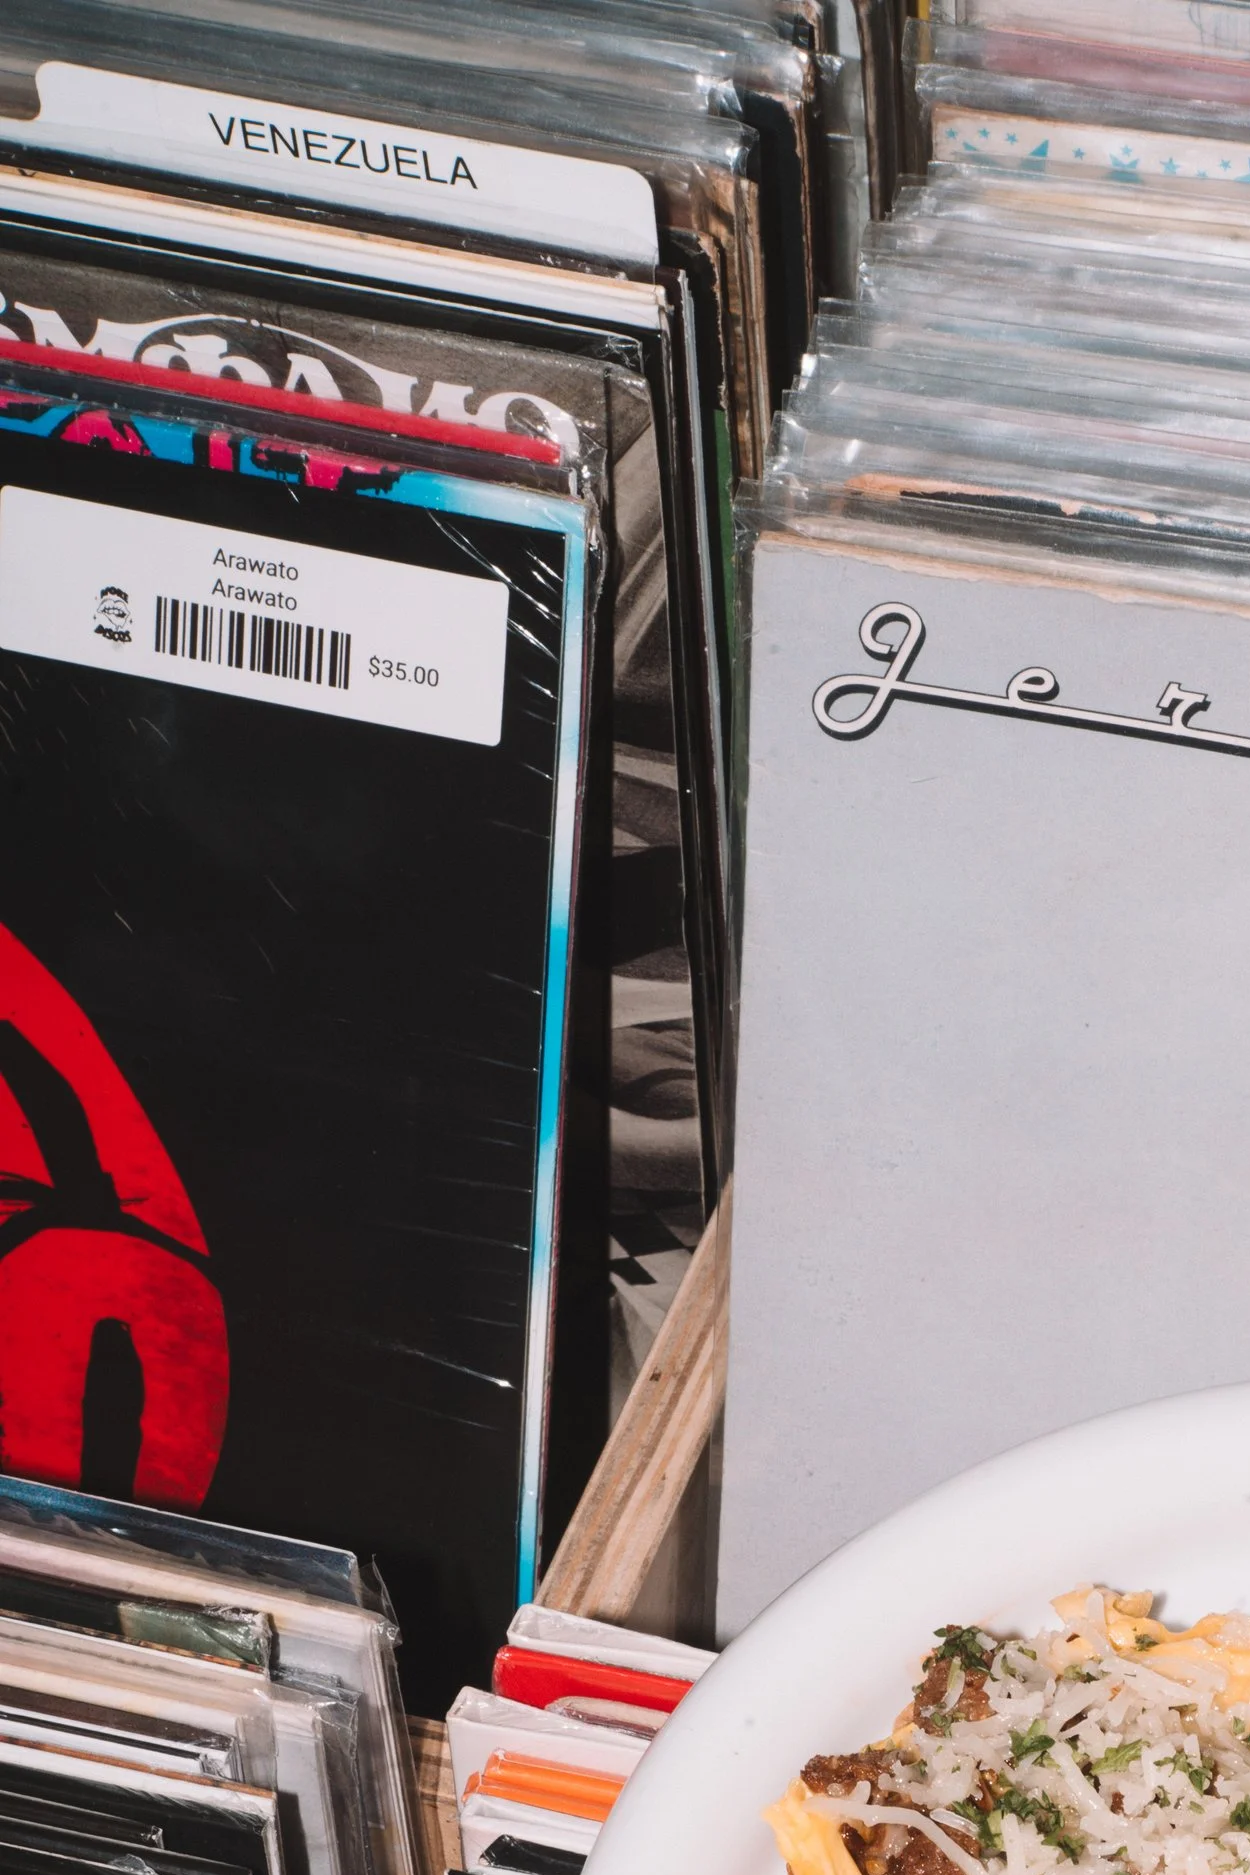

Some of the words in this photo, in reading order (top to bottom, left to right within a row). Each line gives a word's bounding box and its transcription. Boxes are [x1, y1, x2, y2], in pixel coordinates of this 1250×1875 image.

[208, 112, 478, 189] VENEZUELA
[213, 548, 299, 581] Arawato
[211, 578, 298, 611] Arawato
[368, 655, 440, 687] $35.00
